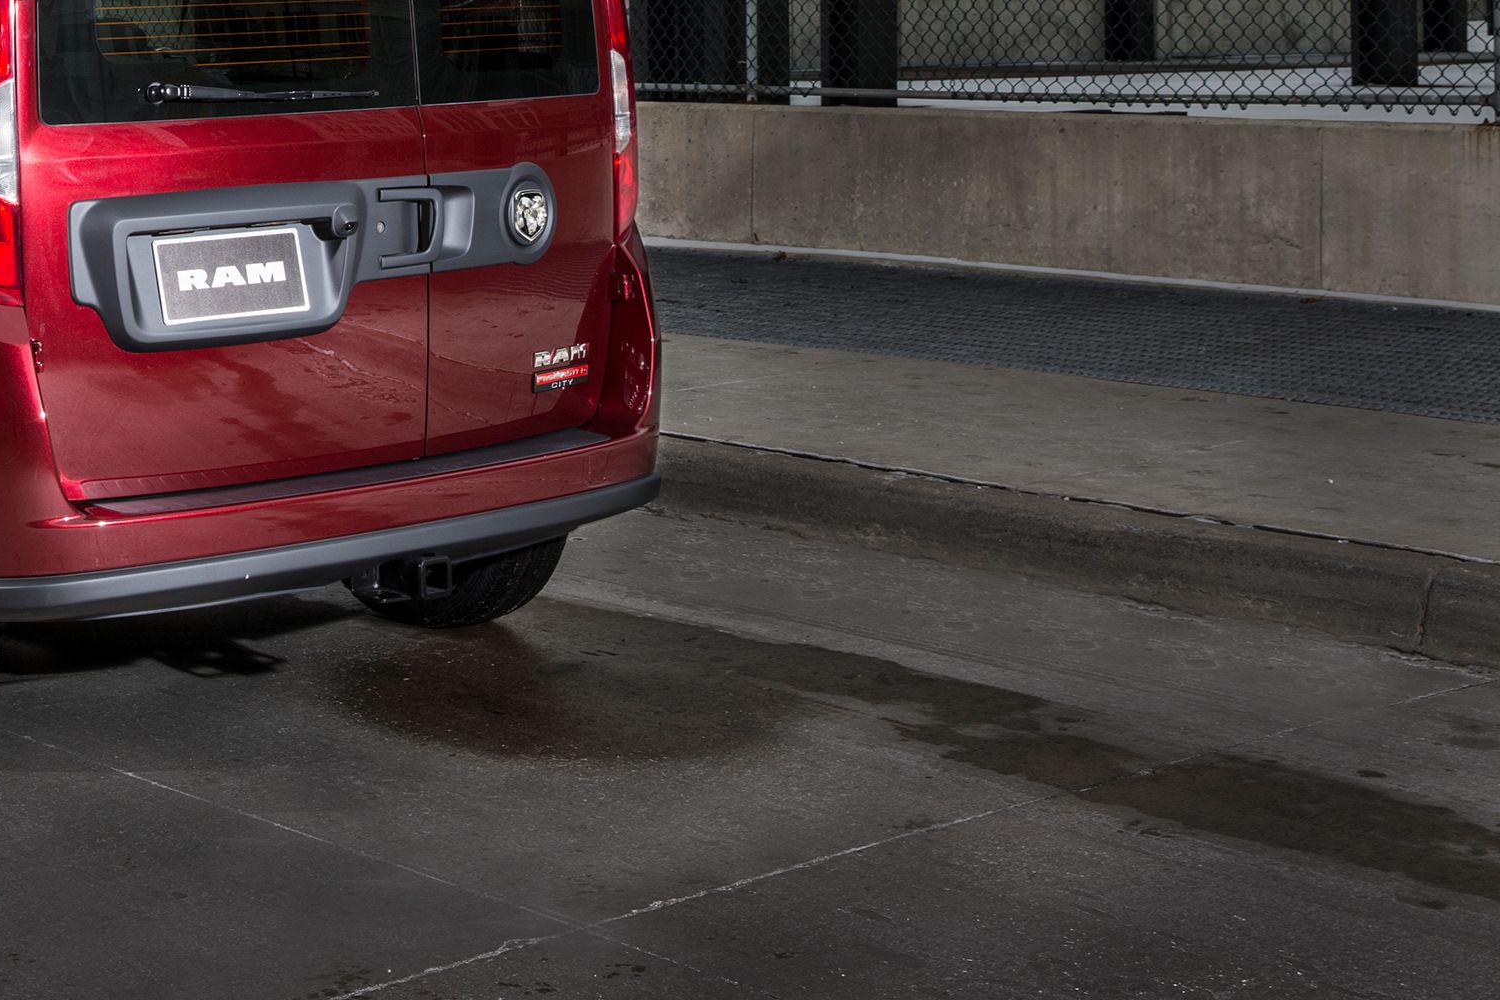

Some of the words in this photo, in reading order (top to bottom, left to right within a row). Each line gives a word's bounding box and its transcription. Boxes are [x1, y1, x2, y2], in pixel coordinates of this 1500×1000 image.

[176, 261, 287, 291] RAM
[534, 343, 589, 368] RAM
[551, 379, 574, 389] CITY
